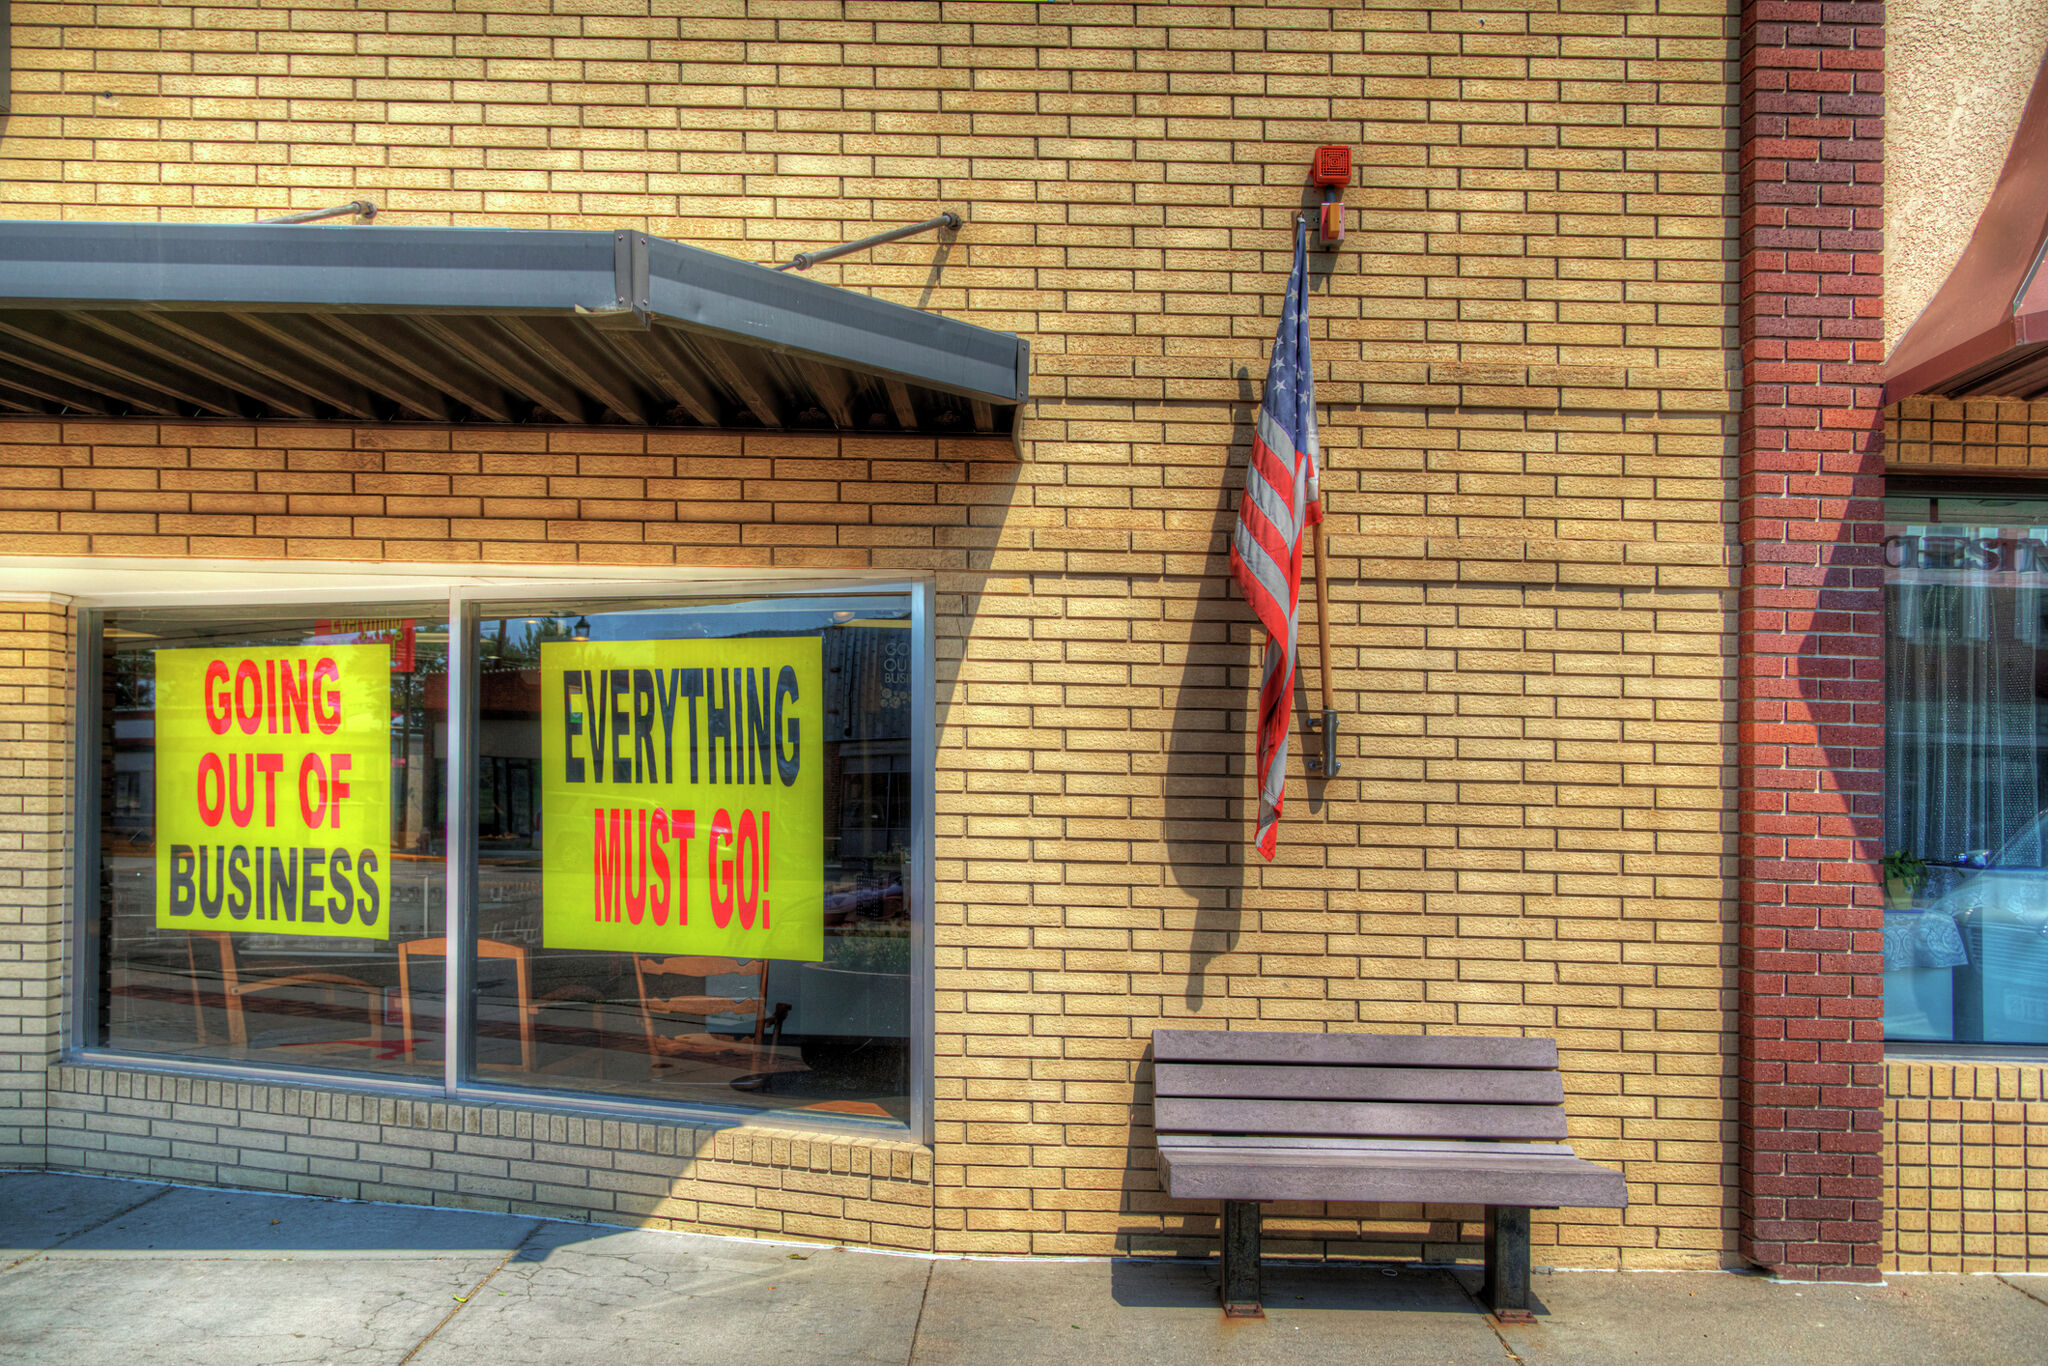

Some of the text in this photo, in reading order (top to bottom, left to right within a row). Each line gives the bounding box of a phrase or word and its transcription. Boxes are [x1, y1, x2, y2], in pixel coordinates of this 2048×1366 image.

[204, 658, 341, 735] GOING
[563, 665, 800, 787] EVERYTHING
[197, 752, 352, 829] OUT OF
[169, 844, 380, 927] BUSINESS
[594, 808, 771, 930] MUST GO!
